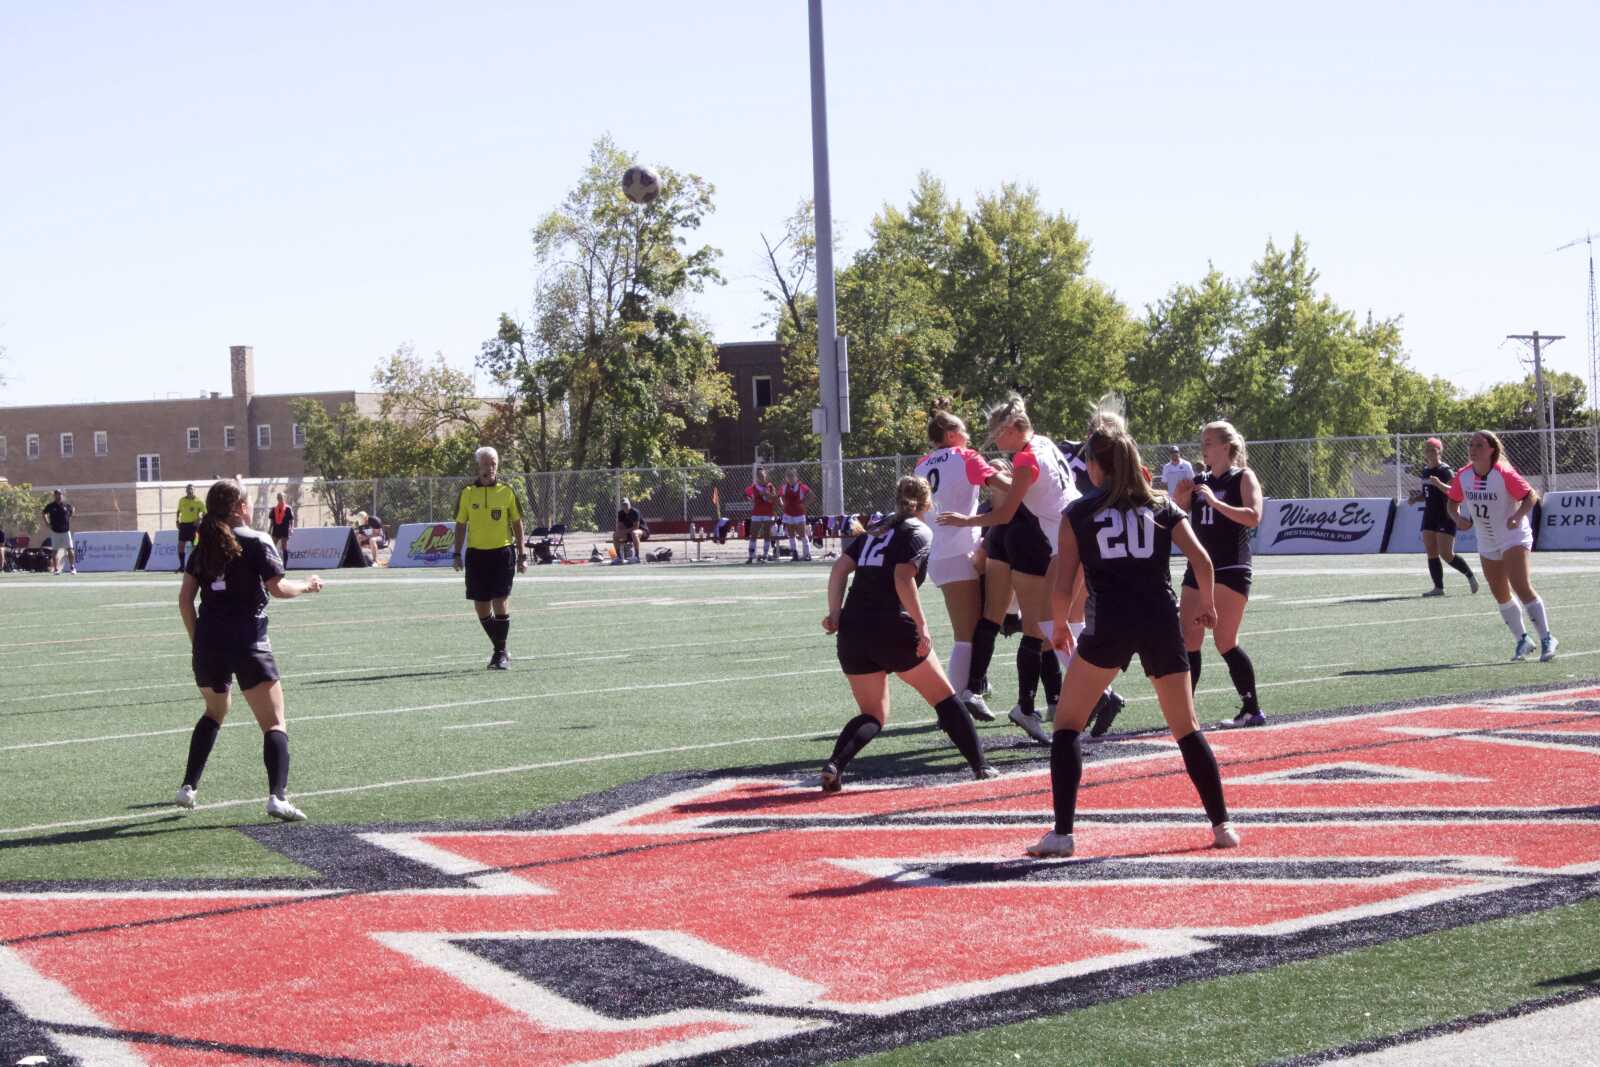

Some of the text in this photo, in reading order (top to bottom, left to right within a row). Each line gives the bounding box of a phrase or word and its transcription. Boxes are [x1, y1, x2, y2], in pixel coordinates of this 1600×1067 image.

[1473, 503, 1490, 519] 22
[1561, 495, 1600, 508] UNI
[1200, 505, 1214, 525] 11
[1279, 502, 1376, 529] Wings Etc.
[1547, 514, 1600, 526] EXPR
[1093, 506, 1155, 559] 20
[858, 527, 896, 567] 12
